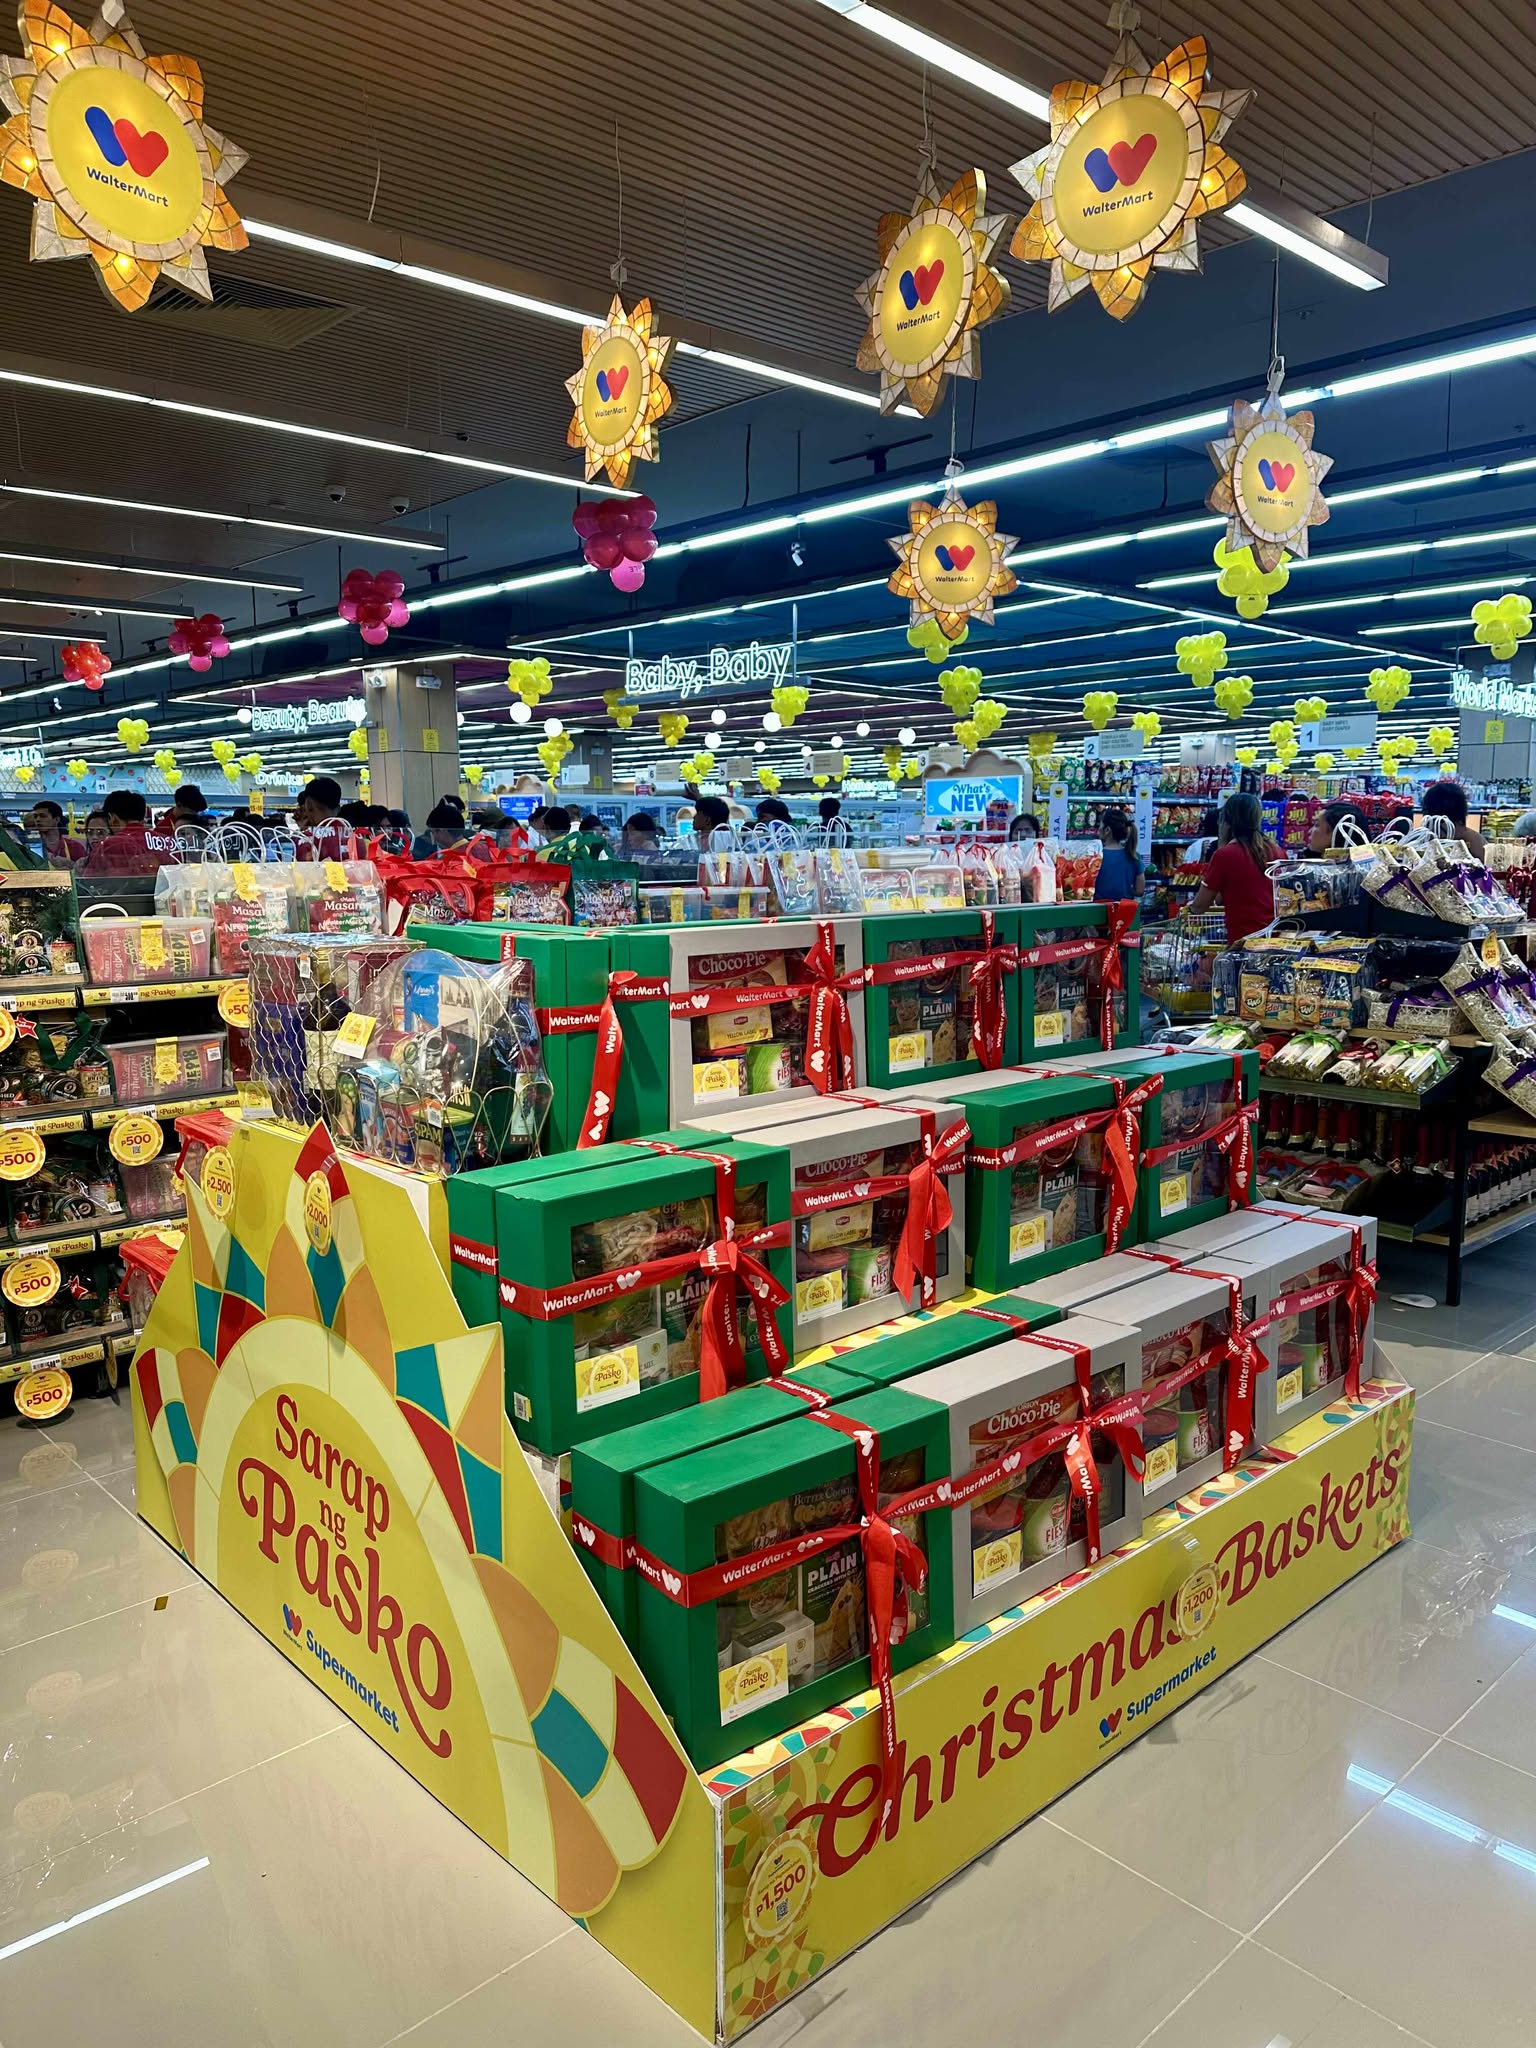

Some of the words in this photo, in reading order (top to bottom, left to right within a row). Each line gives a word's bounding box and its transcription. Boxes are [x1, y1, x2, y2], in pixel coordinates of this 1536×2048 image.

[86, 166, 168, 207] WalterMart
[1083, 191, 1153, 217] WalterMart
[896, 310, 940, 332] WalterMart
[594, 406, 627, 418] WalterMart
[1257, 495, 1294, 508] WalterMart
[935, 575, 975, 583] WalterMart
[625, 654, 704, 698] Baby,
[710, 641, 791, 687] Baby
[252, 704, 308, 733] Beauty,
[1306, 731, 1313, 742] 1
[1087, 744, 1095, 754] 2
[805, 762, 811, 771] 4
[920, 757, 925, 767] 3
[952, 783, 991, 794] What's
[951, 794, 992, 812] NEW
[1139, 815, 1147, 840] U.S.A.
[1055, 945, 1085, 957] WalterMart
[894, 963, 932, 976] WalterMart
[151, 989, 176, 997] Pasko
[736, 990, 784, 1004] WalterMart
[1061, 985, 1085, 997] PLAIN
[39, 997, 65, 1006] Pasko
[922, 1003, 952, 1016] PLAIN
[812, 986, 827, 1048] WalterMart
[159, 1106, 184, 1116] Pasko
[36, 1124, 46, 1132] ng
[47, 1120, 75, 1130] Pasko
[414, 1121, 441, 1141] SPAM
[1035, 1125, 1074, 1148] WalterMart
[1237, 1116, 1250, 1169] WalterMart
[1045, 1174, 1075, 1193] PLAIN
[804, 1188, 853, 1208] WalterMart
[62, 1242, 89, 1251] Pasko
[542, 1282, 615, 1313] WalterMart
[665, 1279, 711, 1306] PLAIN
[1300, 1289, 1326, 1307] WalterMart
[68, 1351, 94, 1363] Pasko
[594, 1367, 623, 1383] Pasko
[599, 1363, 616, 1373] Sarap
[1166, 1363, 1199, 1391] WalterMart
[275, 1393, 390, 1542] Sarap
[319, 1499, 347, 1550] ng
[1215, 1448, 1402, 1606] Baskets
[722, 1549, 793, 1585] WalterMart
[807, 1552, 858, 1587] PLAIN
[808, 1579, 833, 1594] CRACKERS
[237, 1457, 453, 1759] Pasko
[740, 1671, 769, 1689] Pasko
[745, 1666, 762, 1677] Sarap
[306, 1629, 399, 1734] Supermarket
[1126, 1645, 1217, 1722] Supermarket
[881, 1673, 894, 1757] WalterMart
